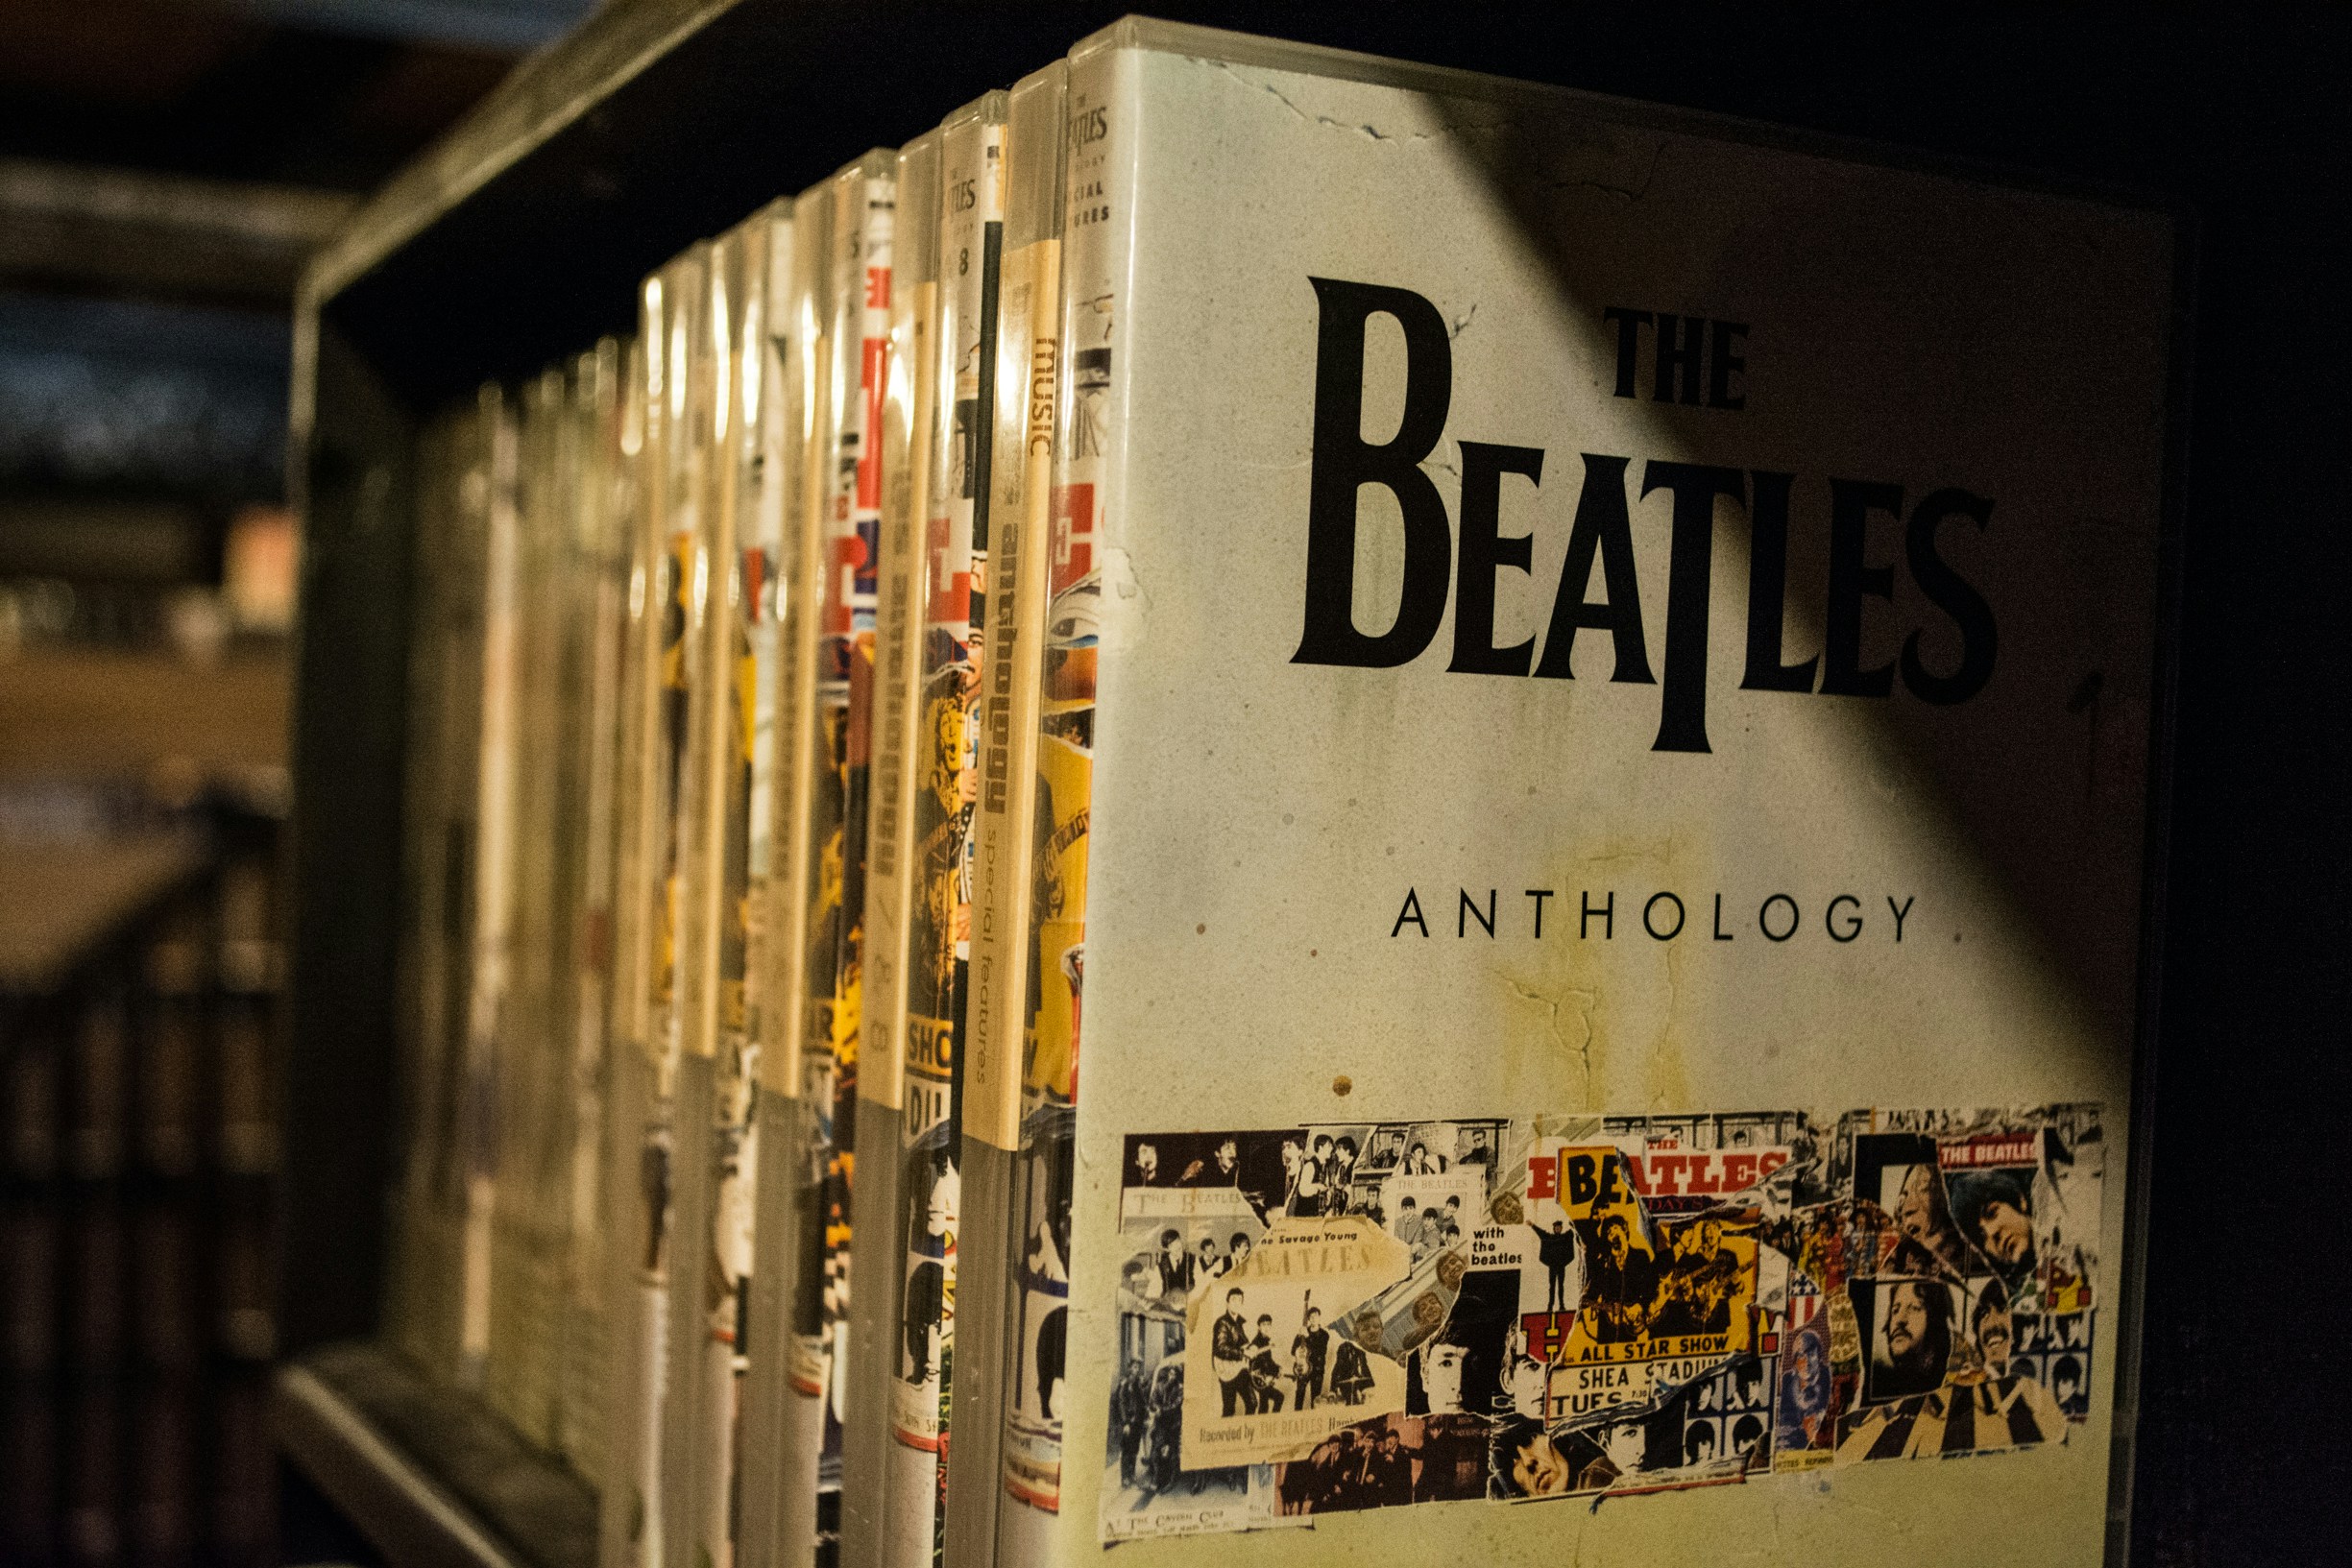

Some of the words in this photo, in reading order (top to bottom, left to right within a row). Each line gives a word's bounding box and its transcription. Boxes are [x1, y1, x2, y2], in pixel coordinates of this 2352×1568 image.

[958, 248, 969, 276] 8
[1603, 305, 1751, 410] THE
[1030, 337, 1055, 458] music
[1289, 276, 1999, 754] BEATLES
[983, 828, 997, 942] special
[1391, 886, 1914, 943] ANTHOLOGY
[977, 958, 993, 1084] features
[1648, 1140, 1679, 1150] THE
[1941, 1145, 1971, 1165] THE
[1975, 1142, 2035, 1163] BEATLES
[1278, 1235, 1321, 1244] Savage
[1323, 1232, 1358, 1242] Young
[1473, 1226, 1504, 1240] with
[1471, 1252, 1522, 1266] beatles
[1472, 1241, 1496, 1253] the
[1580, 1345, 1613, 1362] ALL
[1625, 1339, 1670, 1359] STAR
[1680, 1335, 1730, 1353] SHOW
[1579, 1367, 1630, 1389] SHEA
[1200, 1425, 1242, 1443] Recorded
[1244, 1423, 1255, 1444] by
[1260, 1421, 1277, 1438] THE
[1281, 1417, 1323, 1437] BEATLES
